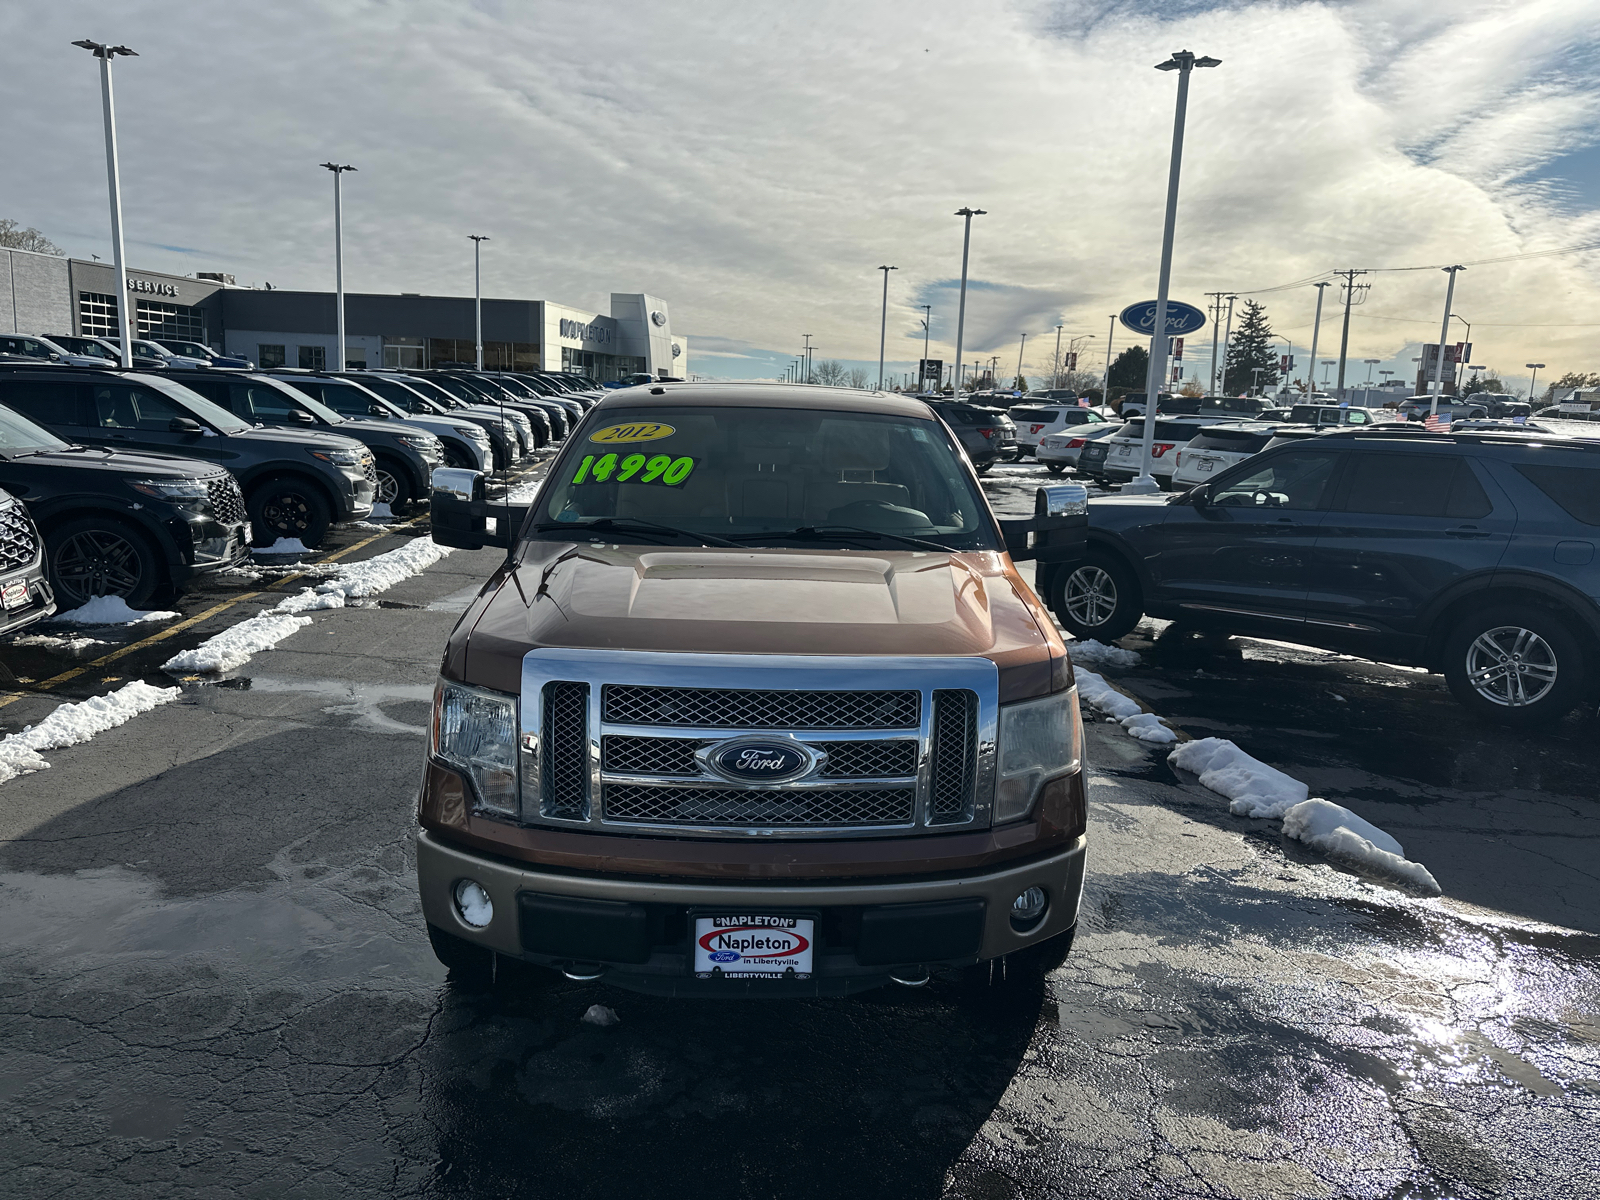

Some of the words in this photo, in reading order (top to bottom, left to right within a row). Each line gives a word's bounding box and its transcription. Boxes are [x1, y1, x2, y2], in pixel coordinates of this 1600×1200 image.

[128, 279, 180, 296] SERVICE
[1140, 306, 1190, 328] Frd
[559, 318, 612, 344] NAPLETON
[601, 425, 661, 440] 2012
[572, 453, 694, 486] 14990
[736, 749, 785, 770] Ford
[721, 916, 789, 927] NAPLETON
[718, 934, 791, 953] Napleton
[714, 952, 735, 961] Ford
[753, 958, 799, 966] Libertyville
